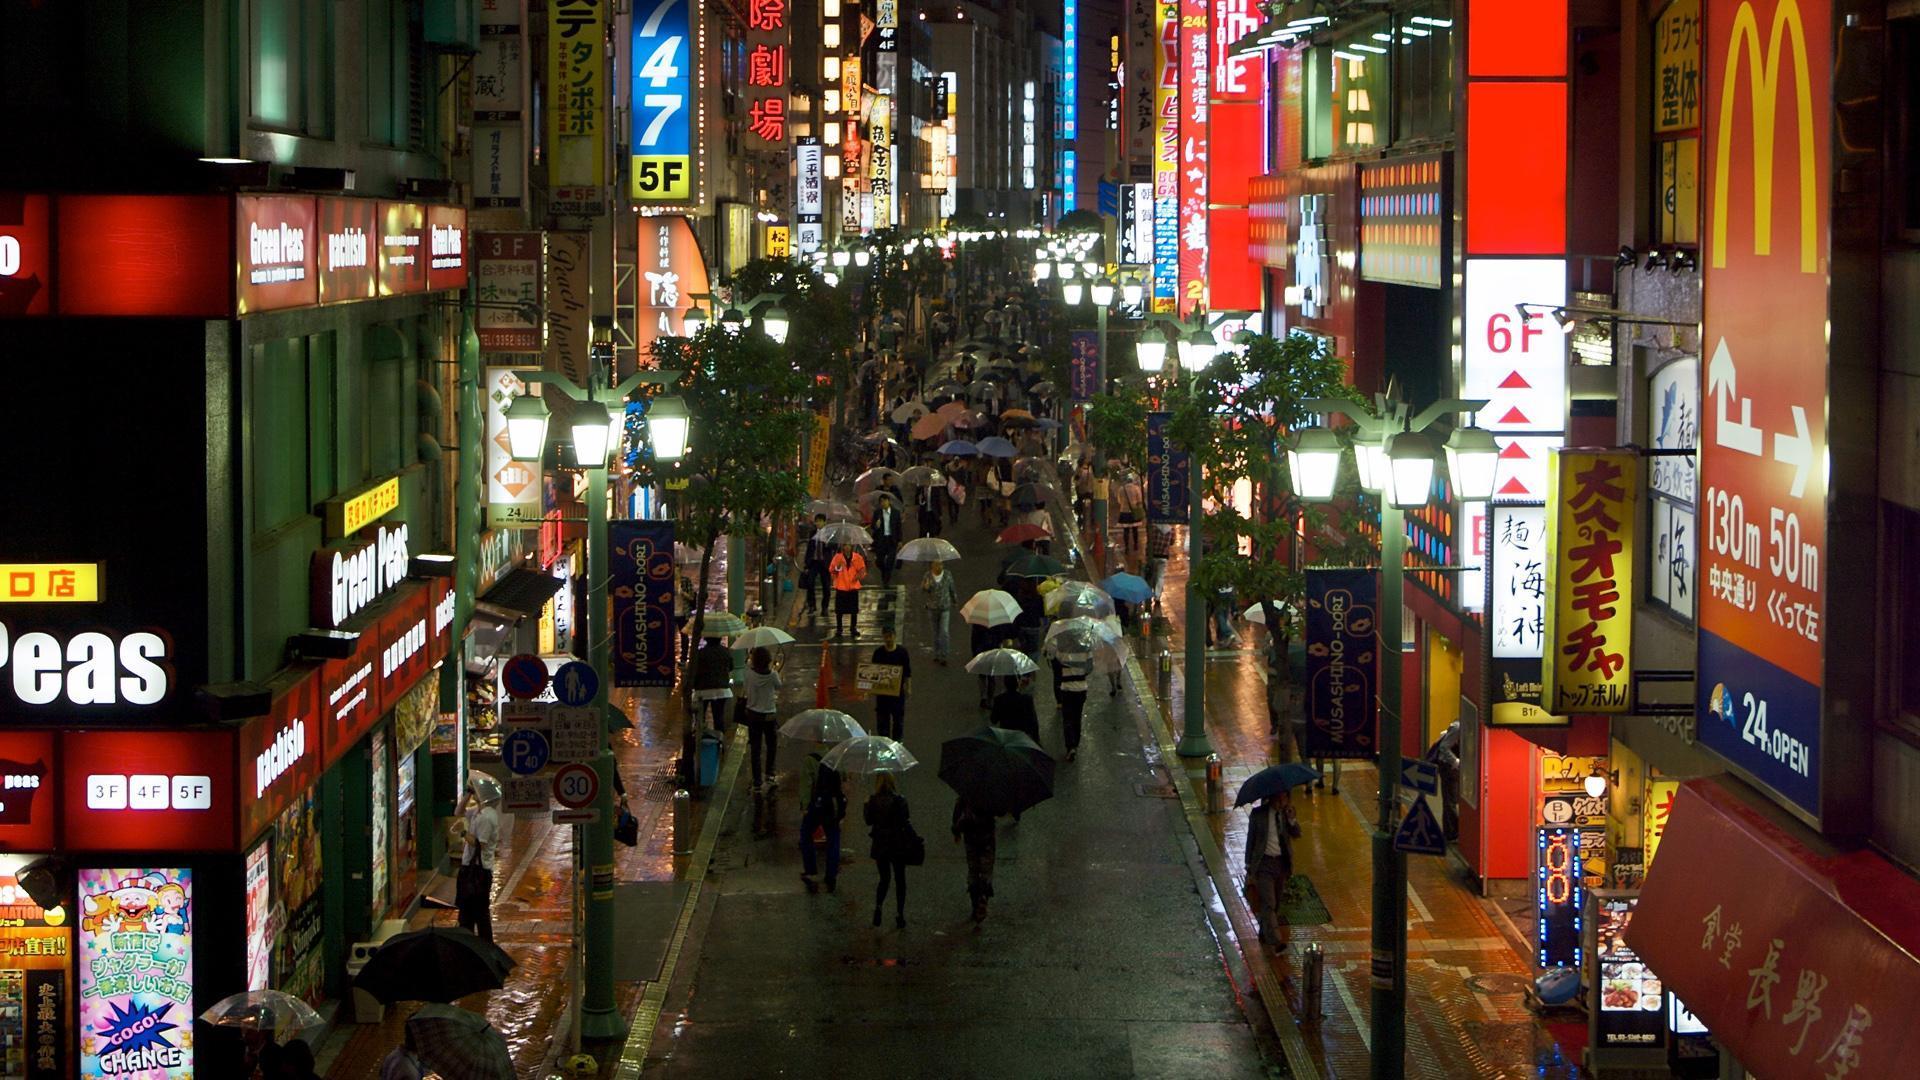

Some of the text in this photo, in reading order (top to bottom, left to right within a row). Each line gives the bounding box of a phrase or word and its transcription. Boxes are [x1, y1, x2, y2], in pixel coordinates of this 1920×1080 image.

[879, 41, 895, 49] 4F
[571, 42, 593, 133] タンポポ
[748, 0, 784, 141] 際劇場
[1662, 62, 1699, 127] 整体
[639, 162, 683, 192] 5F
[872, 125, 891, 198] 黄金の蔵
[251, 222, 304, 265] Green Peas
[481, 281, 535, 302] 味 王
[1486, 313, 1544, 353] 6F
[1707, 487, 1760, 570] 130m
[1770, 507, 1819, 592] 50m
[332, 544, 376, 627] Green
[378, 523, 409, 594] Peas
[1563, 460, 1627, 682] 大人のオモチャ
[1709, 562, 1757, 613] 中央通り
[634, 543, 649, 675] MUSASHINO-DORI
[1767, 587, 1819, 643] くぐって左
[0, 621, 167, 705] eas
[1331, 595, 1345, 743] MUSASHINO-DORI
[1522, 707, 1537, 717] B1F
[1561, 683, 1627, 709] トップポルノ
[257, 718, 304, 799] pachislo
[511, 739, 539, 769] P 40
[4, 775, 40, 790] peas
[95, 785, 119, 799] 3F
[137, 785, 161, 799] 4F
[179, 785, 204, 799] 5F
[563, 776, 589, 796] 30
[112, 932, 162, 952] 新宿で
[91, 953, 186, 979] ジャグラーが
[82, 974, 193, 1004] 一番楽しいお店
[110, 1013, 161, 1045] GOGO!
[100, 1048, 182, 1075] CHANCE
